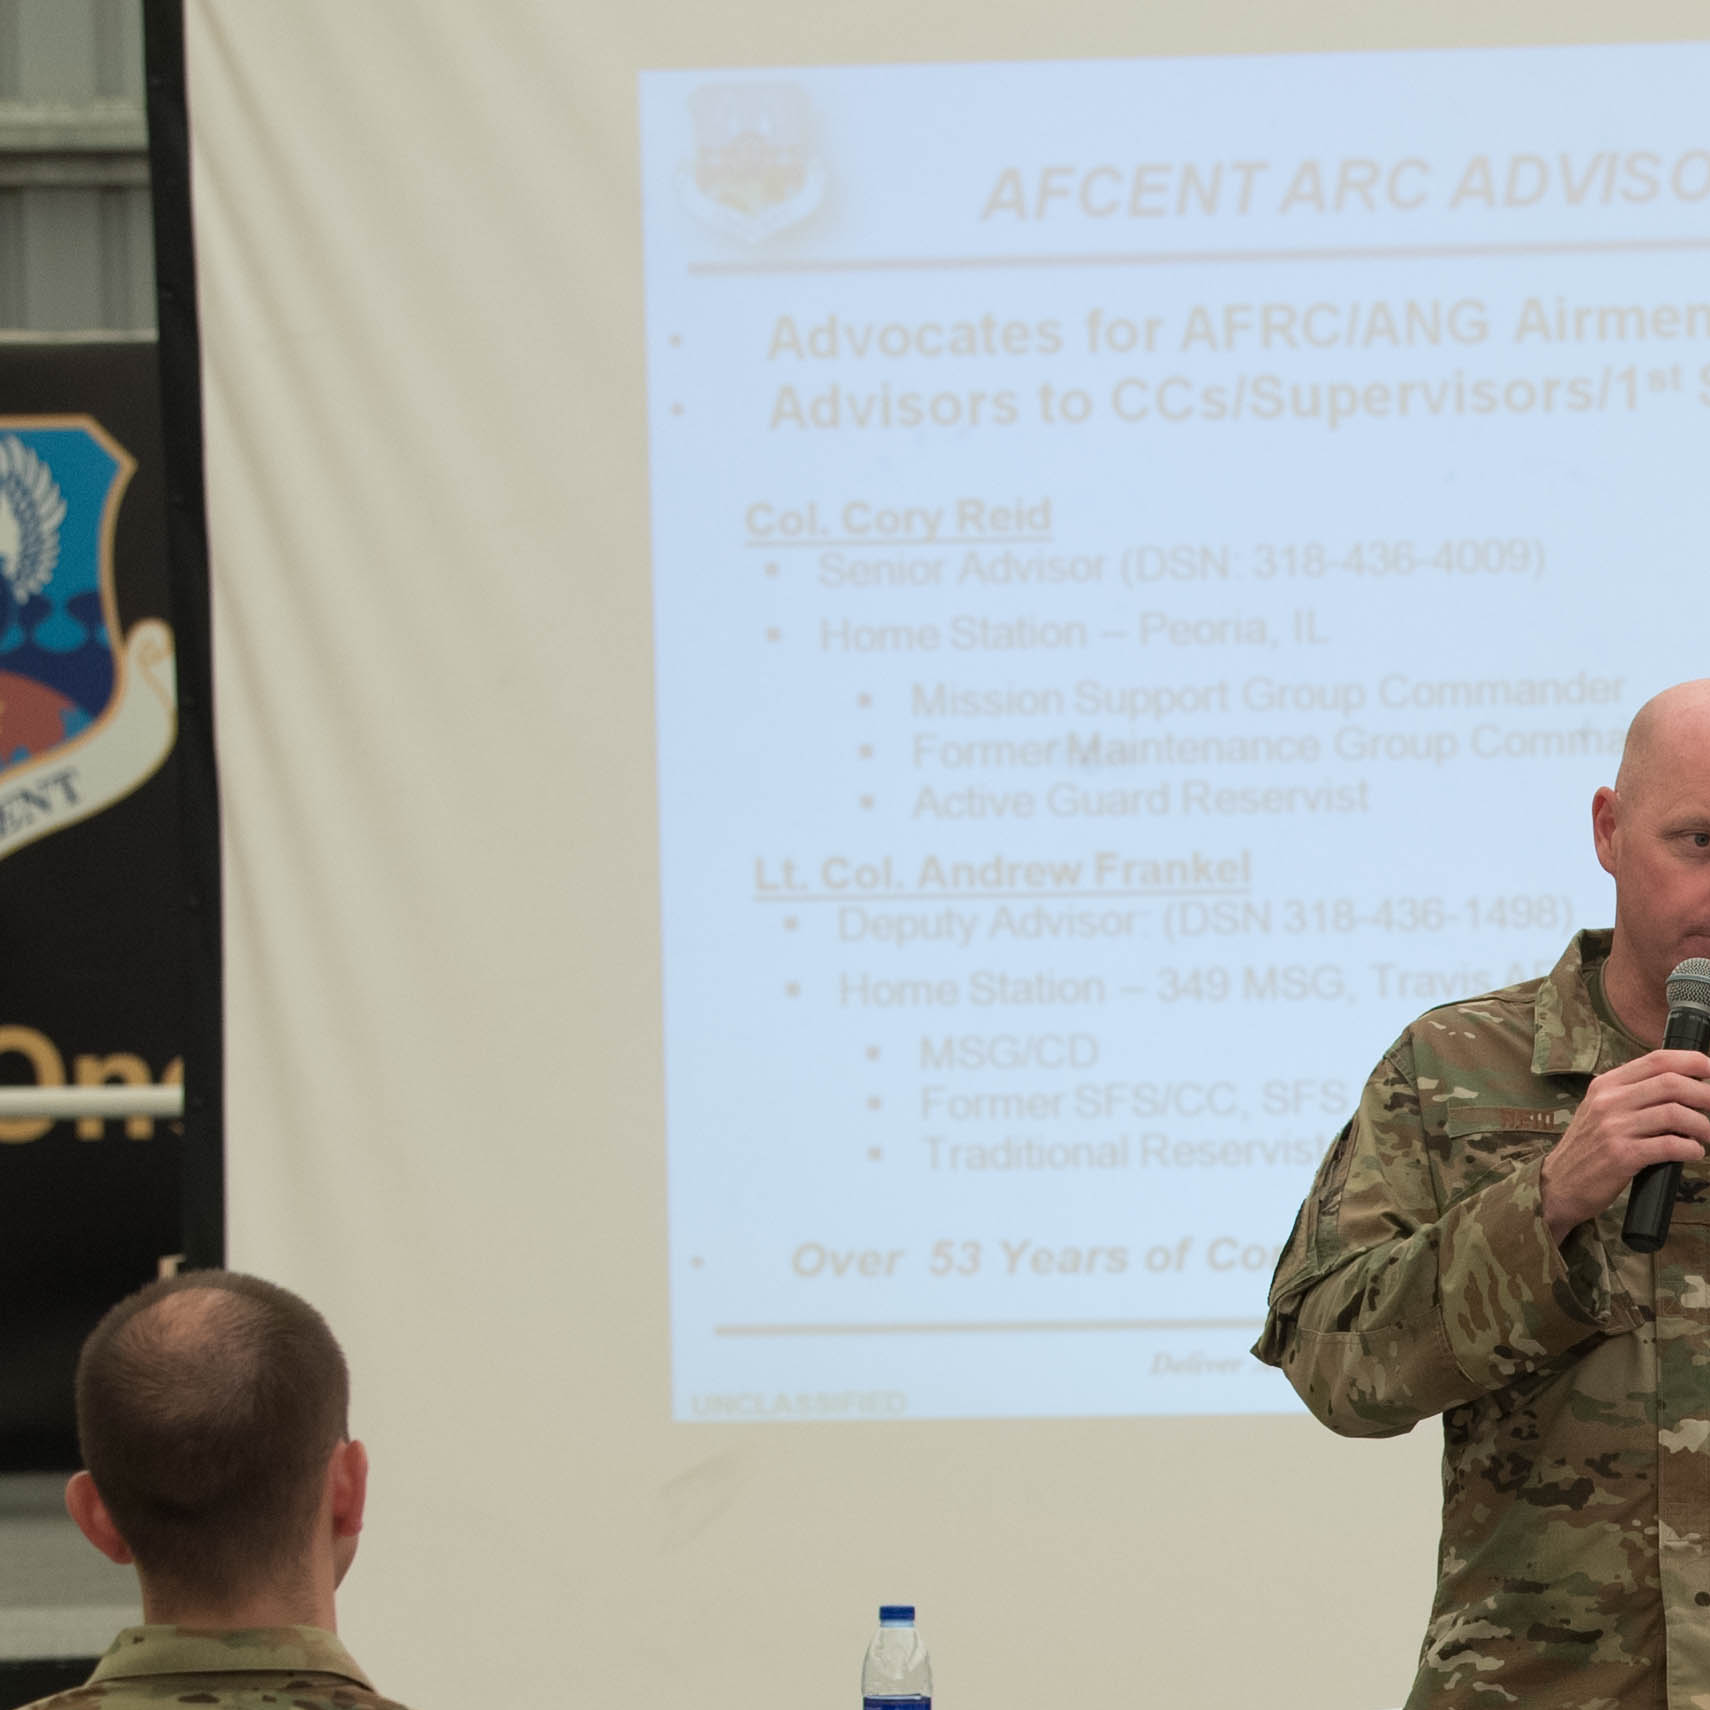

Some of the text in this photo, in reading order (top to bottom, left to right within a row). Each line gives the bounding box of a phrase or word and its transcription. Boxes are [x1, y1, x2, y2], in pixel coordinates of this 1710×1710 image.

[978, 160, 1269, 222] AFCENT
[1277, 156, 1431, 215] ARC
[764, 312, 1064, 362] Advocates
[1085, 308, 1163, 354] for
[1180, 298, 1489, 352] AFRC/ANG
[768, 382, 1019, 431] Advisors
[1037, 381, 1094, 425] to
[744, 497, 1055, 540] Col. Cory Reid
[816, 539, 1548, 592] Senior Advisor (DSN: 318-436-4009)
[820, 617, 941, 653] Home
[949, 614, 1088, 651] Station
[1140, 611, 1278, 649] Peoria,
[1293, 608, 1329, 645] IL
[910, 670, 1626, 723] Mission Support Group Commander
[911, 718, 1624, 770] Former Maintenance Group Comma
[911, 779, 1370, 820] Active Guard Reservist
[753, 848, 1253, 892] Lt. Col. Andrew Frankel
[836, 905, 981, 950] Deputy
[1162, 898, 1273, 944] (DSN
[1283, 894, 1577, 941] 318-436-1498)
[838, 971, 960, 1008] Home
[968, 969, 1106, 1008] Station
[1158, 966, 1231, 1003] 349
[1242, 963, 1356, 1004] MSG,
[1369, 961, 1494, 999] Travis
[919, 1033, 1099, 1071] MSG/CD
[0, 1023, 184, 1144] On
[920, 1084, 1066, 1122] Former
[1073, 1081, 1255, 1125] SFS/CC,
[921, 1135, 1129, 1172] Traditional
[790, 1241, 905, 1279] Over
[929, 1239, 982, 1277] 53
[999, 1238, 1129, 1276] Years
[1144, 1236, 1194, 1274] of
